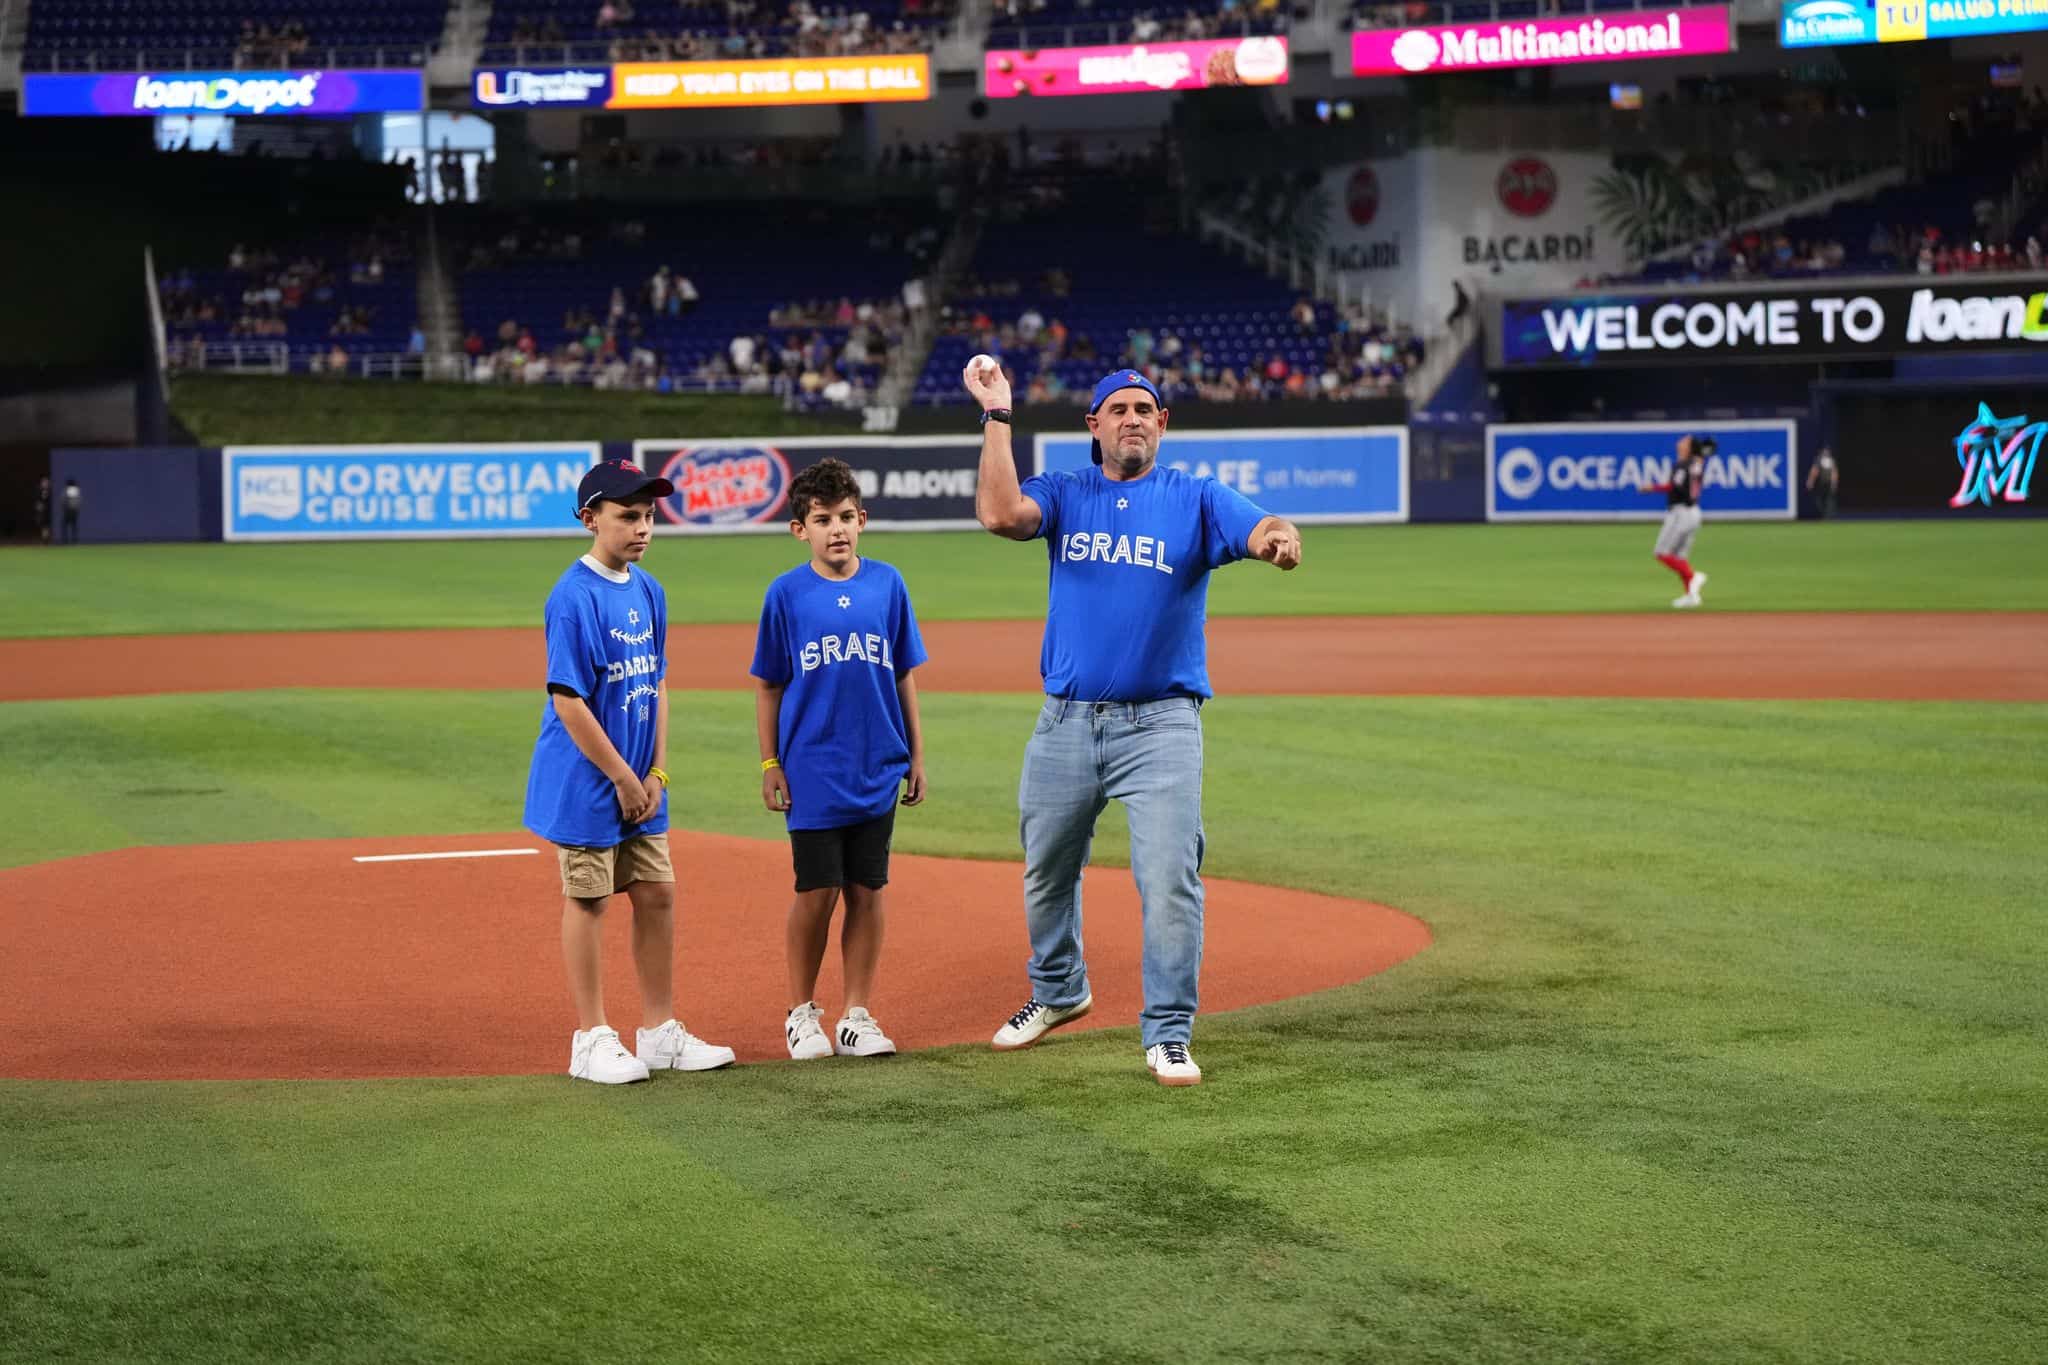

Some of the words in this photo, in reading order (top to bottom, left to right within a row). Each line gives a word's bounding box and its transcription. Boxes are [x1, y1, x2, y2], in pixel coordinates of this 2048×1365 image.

[1439, 13, 1682, 66] Multinational
[134, 76, 316, 114] loanDepot
[1542, 301, 1799, 352] WELCOME
[1812, 297, 1886, 342] TO
[244, 475, 297, 497] NCL
[306, 462, 584, 496] NORWEGIAN
[883, 469, 977, 498] ABOVE
[1548, 455, 1671, 490] OCEAN
[1702, 453, 1782, 488] ANK
[306, 495, 434, 523] CRUISE
[450, 493, 529, 519] LINE
[1061, 532, 1174, 574] ISRAEL
[800, 632, 894, 678] ISRAEL
